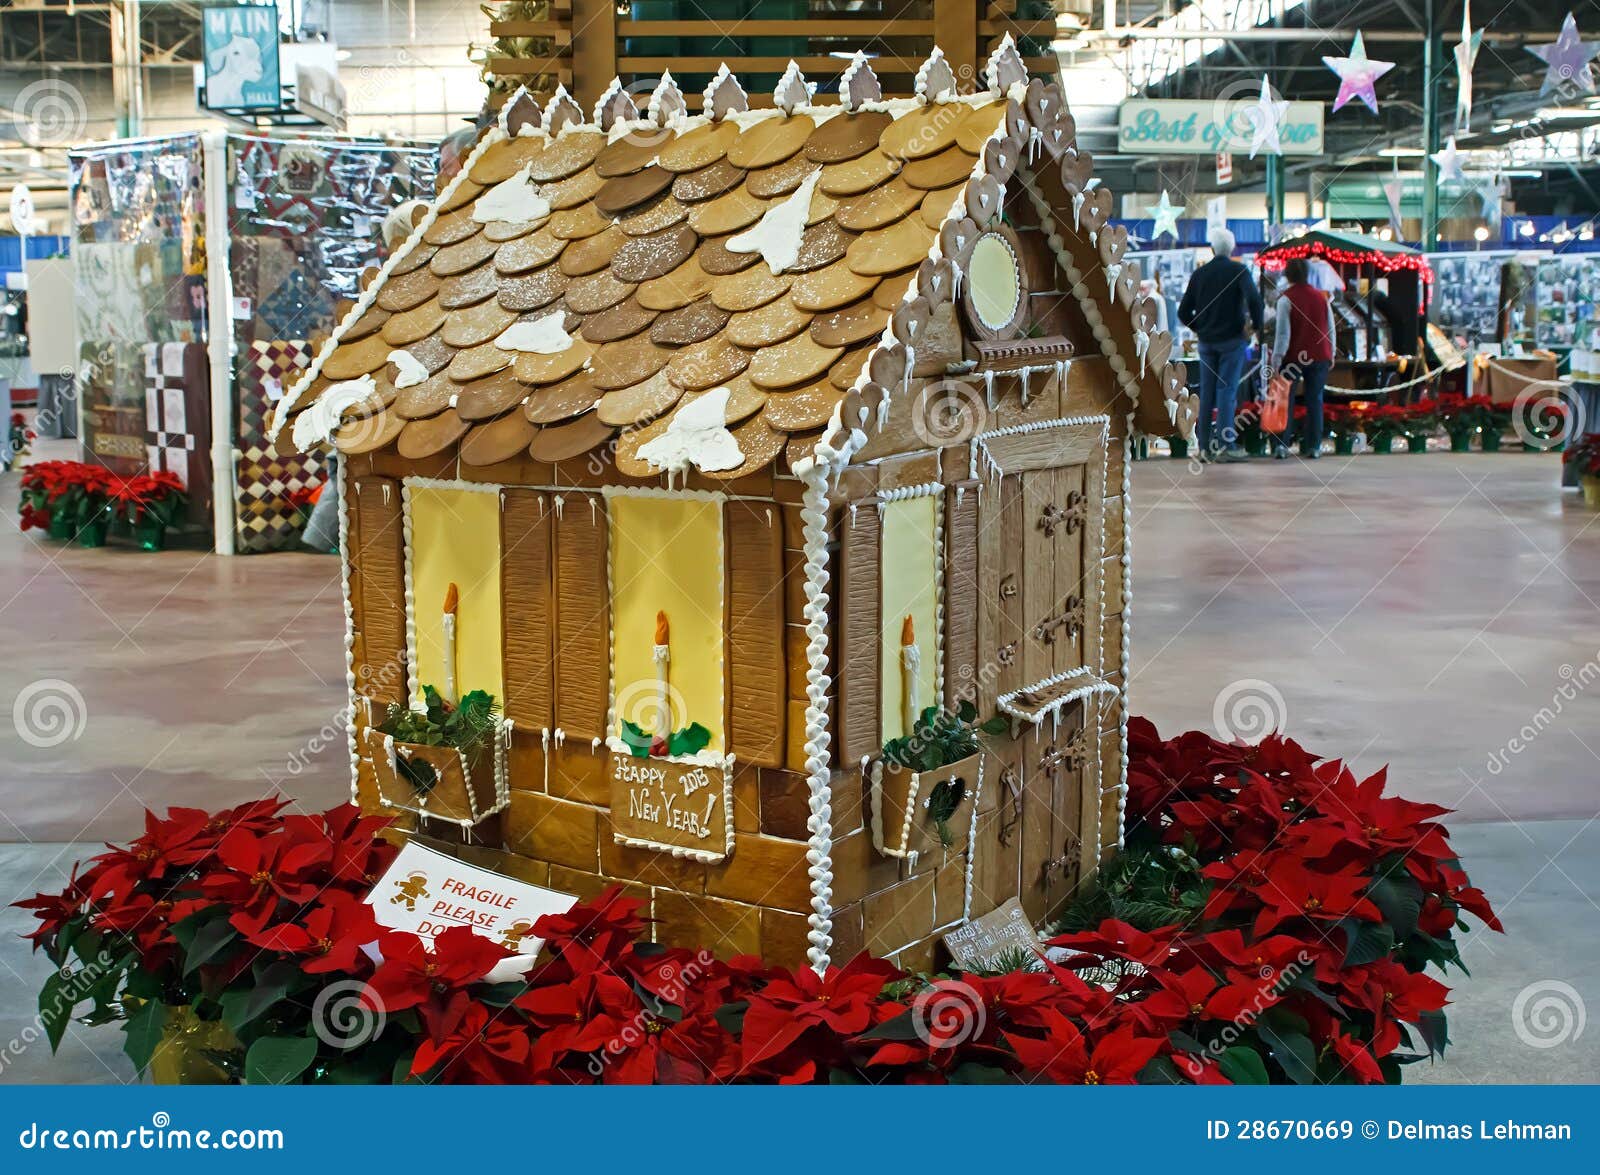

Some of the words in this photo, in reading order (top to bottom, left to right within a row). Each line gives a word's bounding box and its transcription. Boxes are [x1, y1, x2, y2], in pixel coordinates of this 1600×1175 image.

[210, 10, 271, 33] MAIN
[246, 92, 273, 103] HALL
[1123, 108, 1199, 142] Best
[1202, 111, 1237, 151] of
[614, 756, 667, 790] HAPPY
[660, 791, 717, 839] YEAR!
[441, 877, 518, 911] FRAGILE
[416, 921, 447, 937] DO
[431, 900, 499, 928] PLEASE
